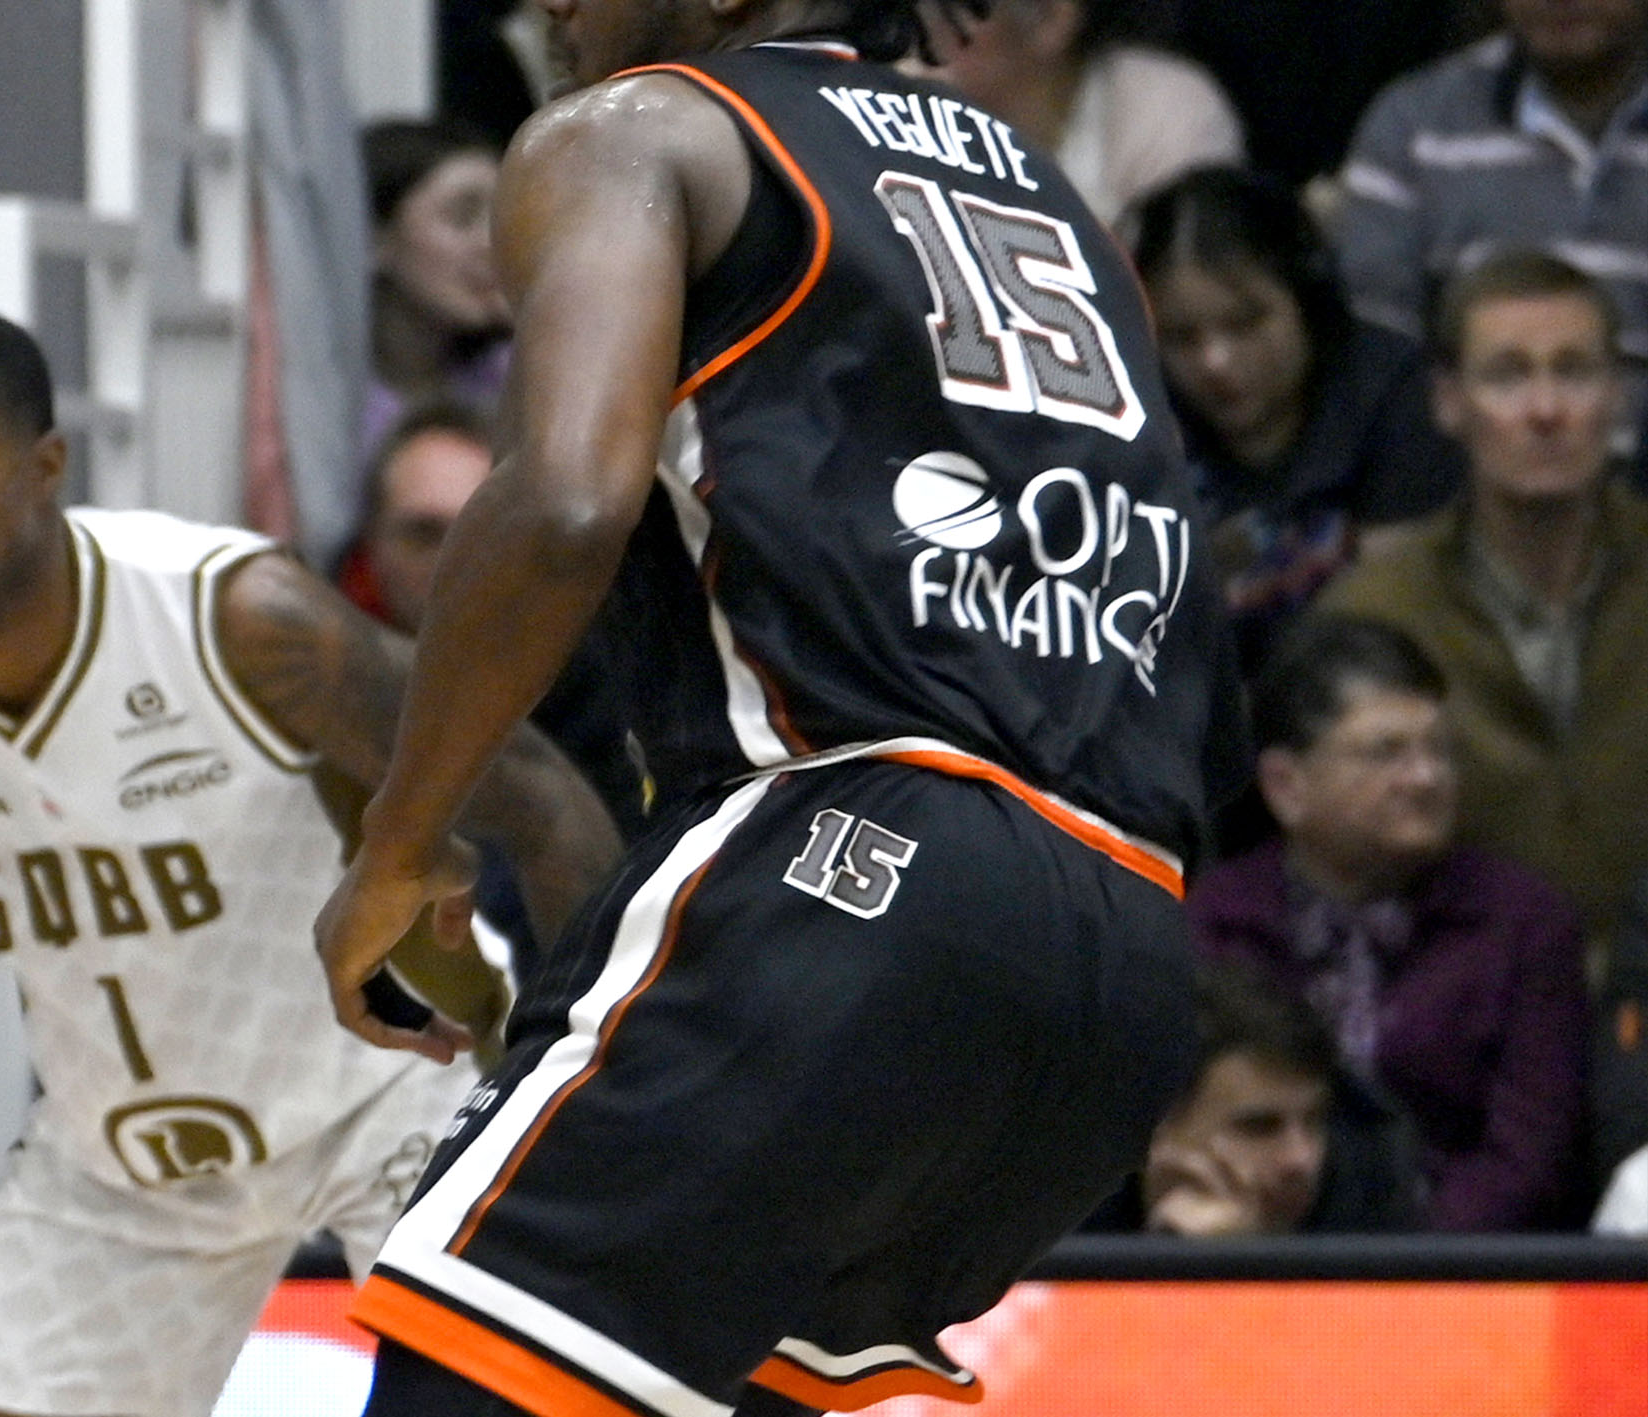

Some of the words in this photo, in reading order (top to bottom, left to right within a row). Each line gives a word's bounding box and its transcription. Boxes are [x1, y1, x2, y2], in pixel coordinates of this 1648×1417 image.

[818, 86, 1039, 191] YEGUETE
[874, 170, 1147, 442] 15
[1017, 466, 1190, 617] OPTI
[782, 807, 919, 920] 15
[96, 974, 155, 1083] 1
